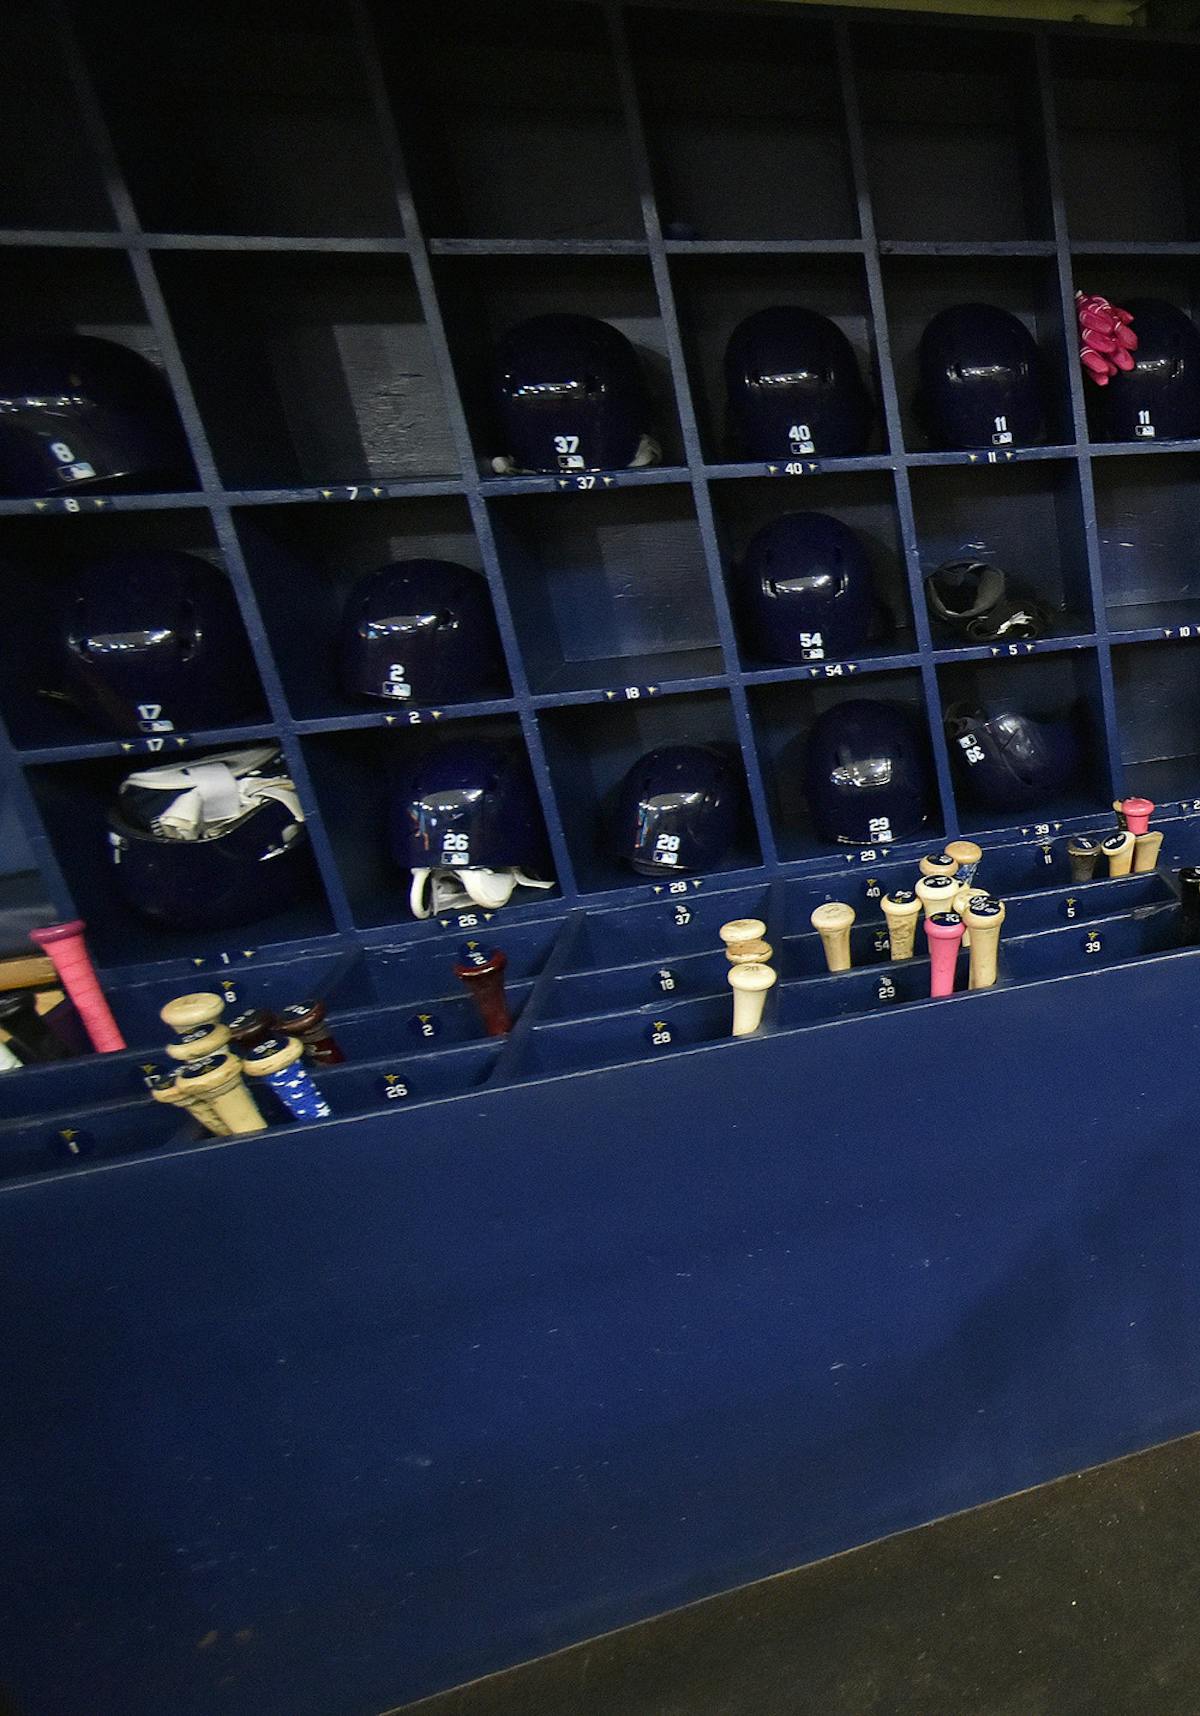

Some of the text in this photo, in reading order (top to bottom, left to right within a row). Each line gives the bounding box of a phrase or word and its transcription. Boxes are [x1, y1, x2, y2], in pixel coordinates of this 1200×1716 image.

[995, 416, 1007, 431] 11
[1139, 411, 1150, 424] 11
[789, 425, 811, 441] 40
[554, 436, 579, 453] 37
[52, 443, 74, 462] 8
[988, 452, 996, 463] 11
[785, 463, 802, 474] 40
[577, 476, 595, 489] 37
[347, 487, 358, 500] 7
[64, 499, 80, 512] 8
[1179, 626, 1191, 637] 10
[800, 633, 822, 647] 54
[1009, 644, 1018, 655] 5
[390, 664, 405, 681] 2
[825, 665, 843, 677] 54
[625, 687, 639, 699] 18
[138, 704, 162, 720] 17
[409, 711, 421, 723] 2
[147, 738, 164, 751] 17
[965, 746, 985, 765] 39
[869, 817, 889, 832] 29
[1034, 824, 1049, 835] 39
[443, 833, 468, 850] 26
[656, 834, 680, 851] 28
[860, 850, 876, 862] 29
[1044, 855, 1052, 864] 11
[669, 882, 687, 893] 28
[866, 887, 881, 898] 40
[1068, 906, 1075, 917] 5
[458, 914, 477, 927] 26
[675, 913, 691, 925] 37
[874, 940, 890, 952] 54
[1085, 941, 1101, 953] 39
[221, 953, 229, 964] 1
[660, 979, 675, 991] 18
[225, 991, 237, 1003] 8
[879, 987, 895, 999] 29
[423, 1024, 434, 1036] 2
[652, 1031, 672, 1044] 28
[386, 1083, 408, 1098] 26
[69, 1142, 79, 1154] 1
